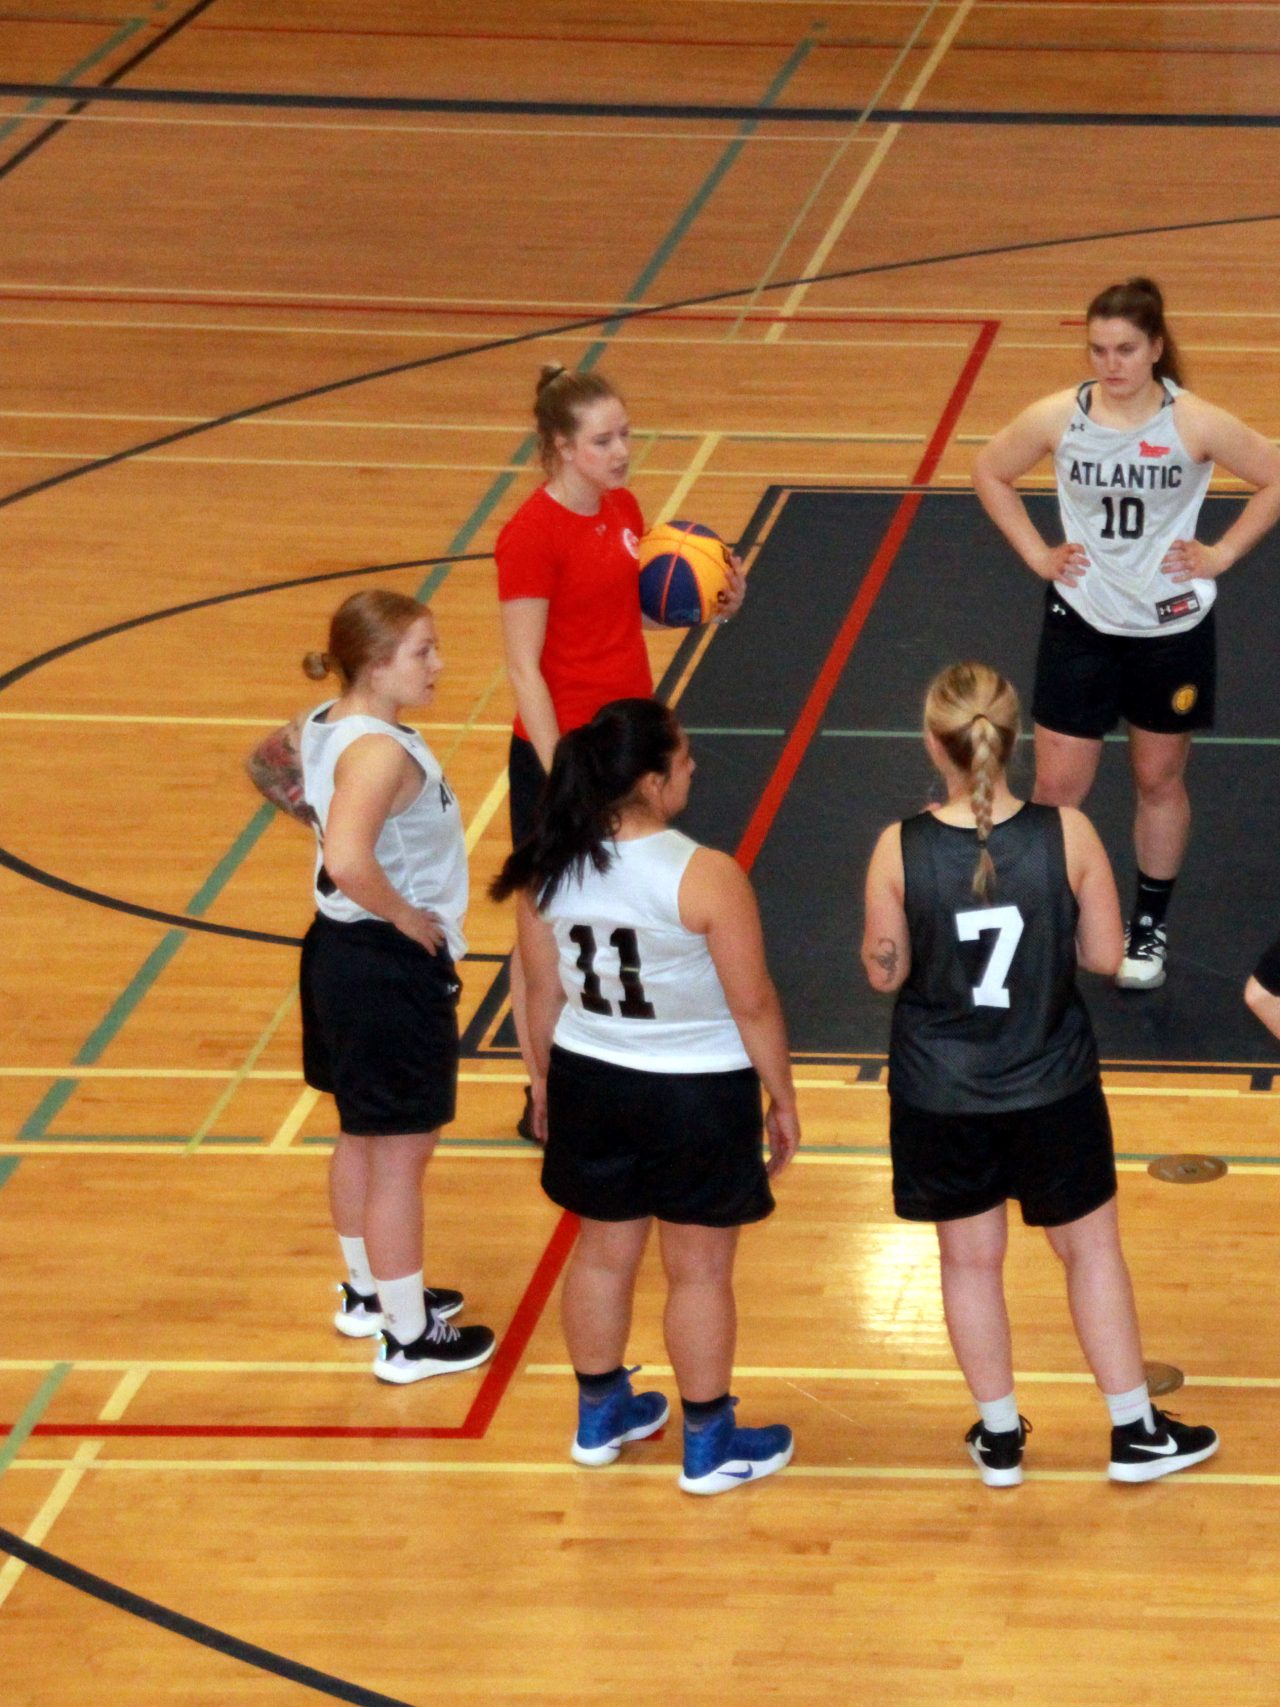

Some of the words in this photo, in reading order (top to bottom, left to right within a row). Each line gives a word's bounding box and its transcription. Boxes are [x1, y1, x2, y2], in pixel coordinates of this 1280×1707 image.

[1070, 460, 1183, 490] ATLANTIC
[1101, 496, 1145, 540] 10
[569, 924, 656, 1020] 11
[955, 905, 1025, 1009] 7
